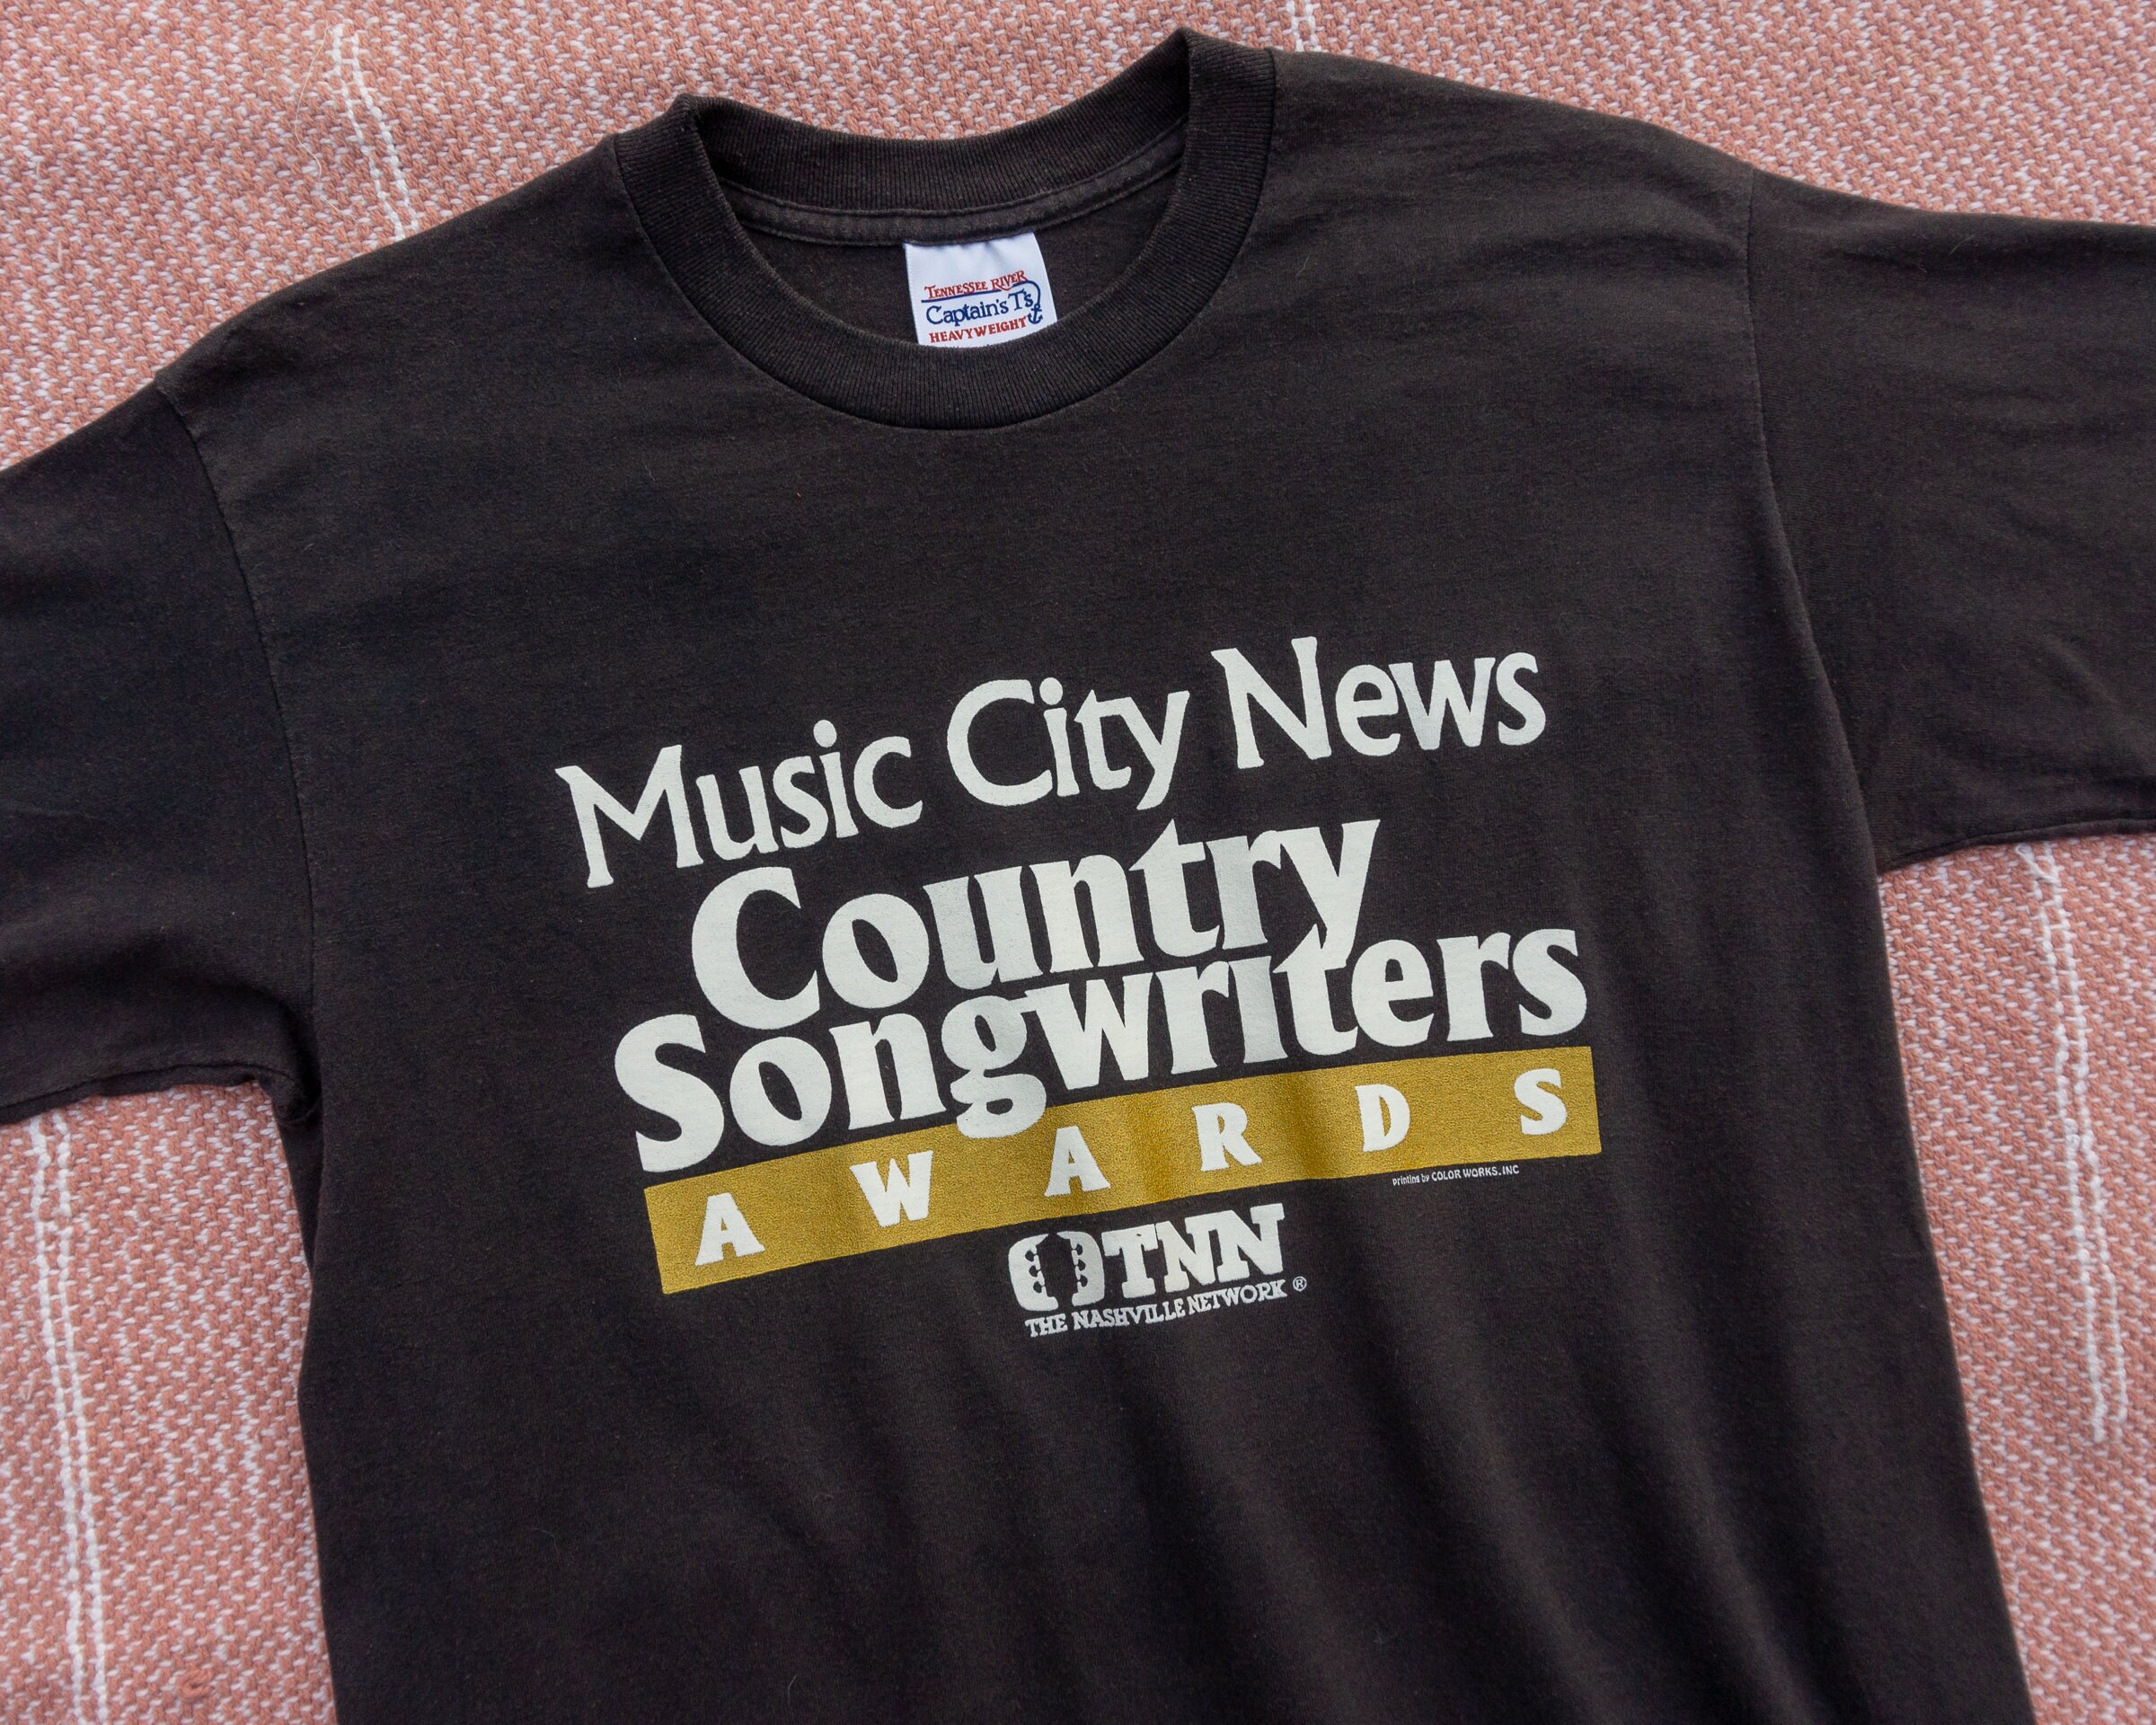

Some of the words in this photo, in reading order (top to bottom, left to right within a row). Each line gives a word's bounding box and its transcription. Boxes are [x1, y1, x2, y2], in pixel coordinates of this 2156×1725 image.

[924, 280, 988, 299] TENNESSEE
[991, 270, 1028, 291] RIVER
[926, 299, 1009, 326] Captain's
[1008, 288, 1034, 311] T's
[929, 316, 1027, 343] HEAVYWEIGHT
[555, 720, 923, 888] Music
[947, 677, 1189, 809] City
[1211, 636, 1546, 769] News
[692, 818, 1380, 1030] Country
[614, 924, 1587, 1172] Songwriters
[695, 1068, 1568, 1266] AWARDS
[1392, 1175, 1420, 1186] printing
[1420, 1173, 1430, 1183] by
[1431, 1169, 1462, 1181] COLOR
[1502, 1164, 1520, 1175] INC
[1101, 1203, 1285, 1298] TNN
[1025, 1313, 1068, 1337] THE
[1072, 1298, 1187, 1330] NASHVILLE
[1187, 1279, 1287, 1314] NETWORK
